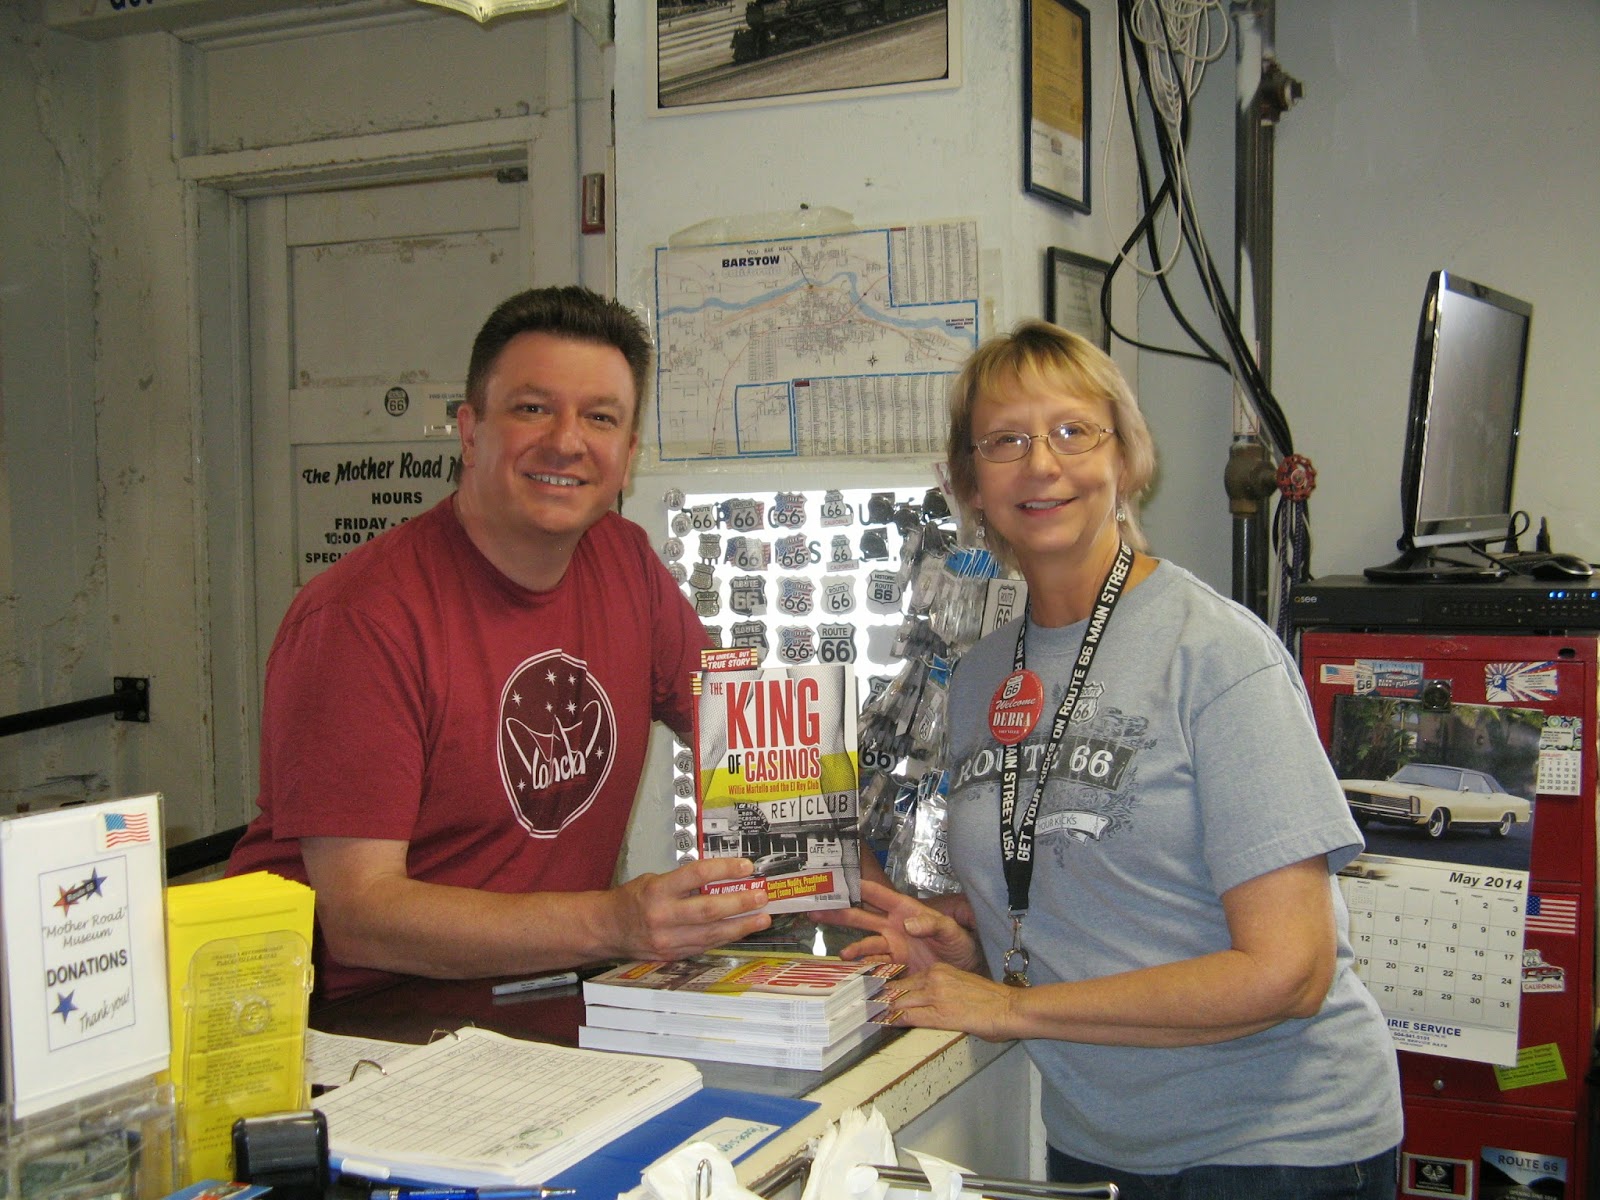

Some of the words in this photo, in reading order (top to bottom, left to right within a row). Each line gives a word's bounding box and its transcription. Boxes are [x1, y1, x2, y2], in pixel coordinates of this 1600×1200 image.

[722, 255, 780, 268] BARSTOW
[389, 400, 404, 411] 66
[302, 469, 330, 484] The
[335, 457, 394, 485] Mother
[400, 452, 443, 479] Road
[372, 492, 423, 505] HOURS
[777, 509, 801, 525] 66
[827, 505, 842, 517] 66
[335, 517, 387, 530] FRIDAY
[693, 516, 712, 529] 66
[734, 512, 755, 528] 66
[325, 533, 361, 544] 10:00
[738, 552, 759, 567] 66
[782, 549, 806, 567] 66
[833, 550, 848, 561] 66
[1101, 553, 1131, 604] STREET
[829, 585, 846, 593] ROUTE
[874, 589, 893, 601] 66
[784, 595, 808, 612] 66
[831, 593, 850, 609] 66
[995, 607, 1011, 629] 66
[1085, 605, 1110, 643] MAIN
[822, 627, 848, 637] ROUTE
[786, 643, 810, 659] 66
[821, 640, 850, 663] 66
[1078, 645, 1094, 667] 66
[708, 661, 727, 670] TRUE
[728, 657, 751, 668] STORY
[710, 682, 723, 695] THE
[1005, 683, 1020, 697] 66
[1059, 669, 1085, 716] ROUTE
[1357, 680, 1372, 690] 66
[995, 698, 1036, 710] Welcome
[1073, 704, 1090, 720] 66
[726, 678, 820, 750] KING
[992, 711, 1031, 727] DEBRA
[1052, 719, 1066, 740] ON
[861, 751, 891, 768] 66
[1004, 743, 1018, 769] AIN
[1039, 742, 1057, 785] KICKS
[1069, 744, 1113, 778] 66
[728, 754, 741, 775] OF
[745, 748, 821, 782] CASINOS
[728, 785, 745, 795] Willie
[746, 784, 768, 794] Martello
[770, 782, 780, 792] and
[780, 782, 789, 792] the
[790, 782, 796, 791] El
[807, 780, 819, 790] Club
[771, 801, 796, 819] REY
[806, 795, 848, 815] CLUB
[1002, 772, 1016, 826] STREET
[1024, 788, 1041, 828] YOUR
[810, 846, 825, 854] CAFE
[1017, 831, 1032, 861] GET
[710, 887, 721, 895] AN
[750, 880, 765, 890] BUT
[767, 881, 787, 890] Contains
[1449, 872, 1480, 887] May
[1484, 877, 1523, 890] 2014
[63, 927, 113, 948] Museum
[47, 949, 128, 987] DONATIONS
[1472, 973, 1483, 981] 23
[1384, 985, 1394, 993] 27
[1470, 997, 1481, 1005] 30
[1500, 1001, 1510, 1009] 31
[80, 1000, 109, 1033] Thank
[1387, 1018, 1409, 1029] IRIE
[1413, 1022, 1461, 1037] SERVICE
[1498, 1155, 1539, 1169] ROUTE
[1543, 1161, 1558, 1172] 66
